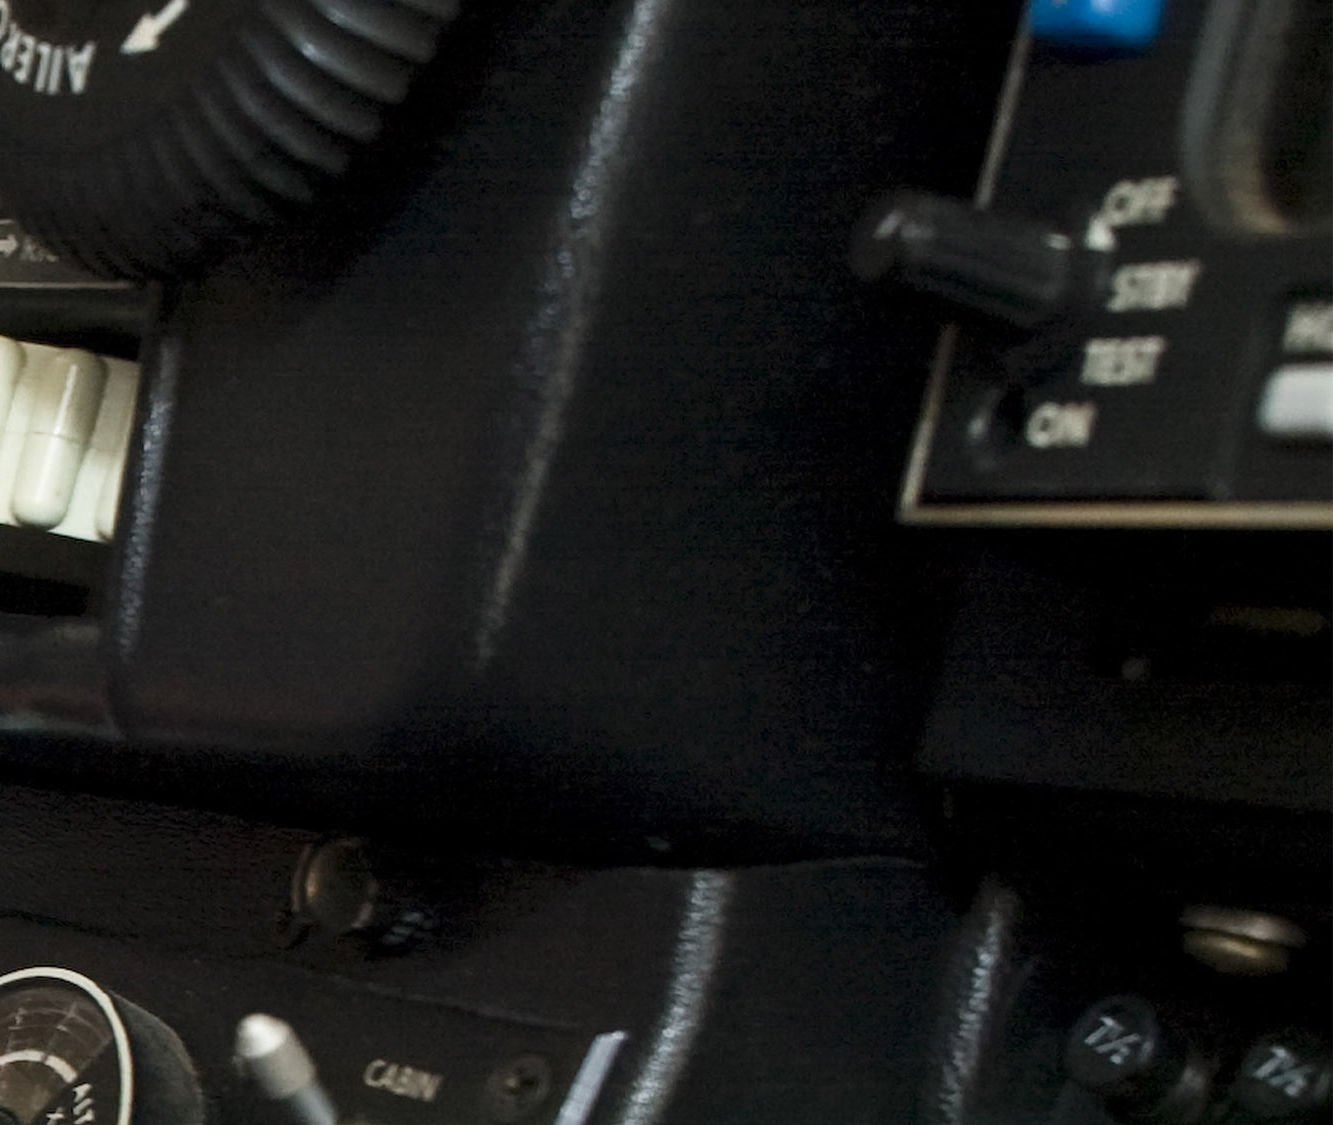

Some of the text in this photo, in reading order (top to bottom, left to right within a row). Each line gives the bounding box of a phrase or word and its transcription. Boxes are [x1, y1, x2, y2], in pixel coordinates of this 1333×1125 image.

[1101, 176, 1178, 227] OFF
[1107, 259, 1200, 311] STBY
[1081, 336, 1165, 385] TEST
[1027, 402, 1096, 447] ON
[363, 1059, 443, 1101] CABIN
